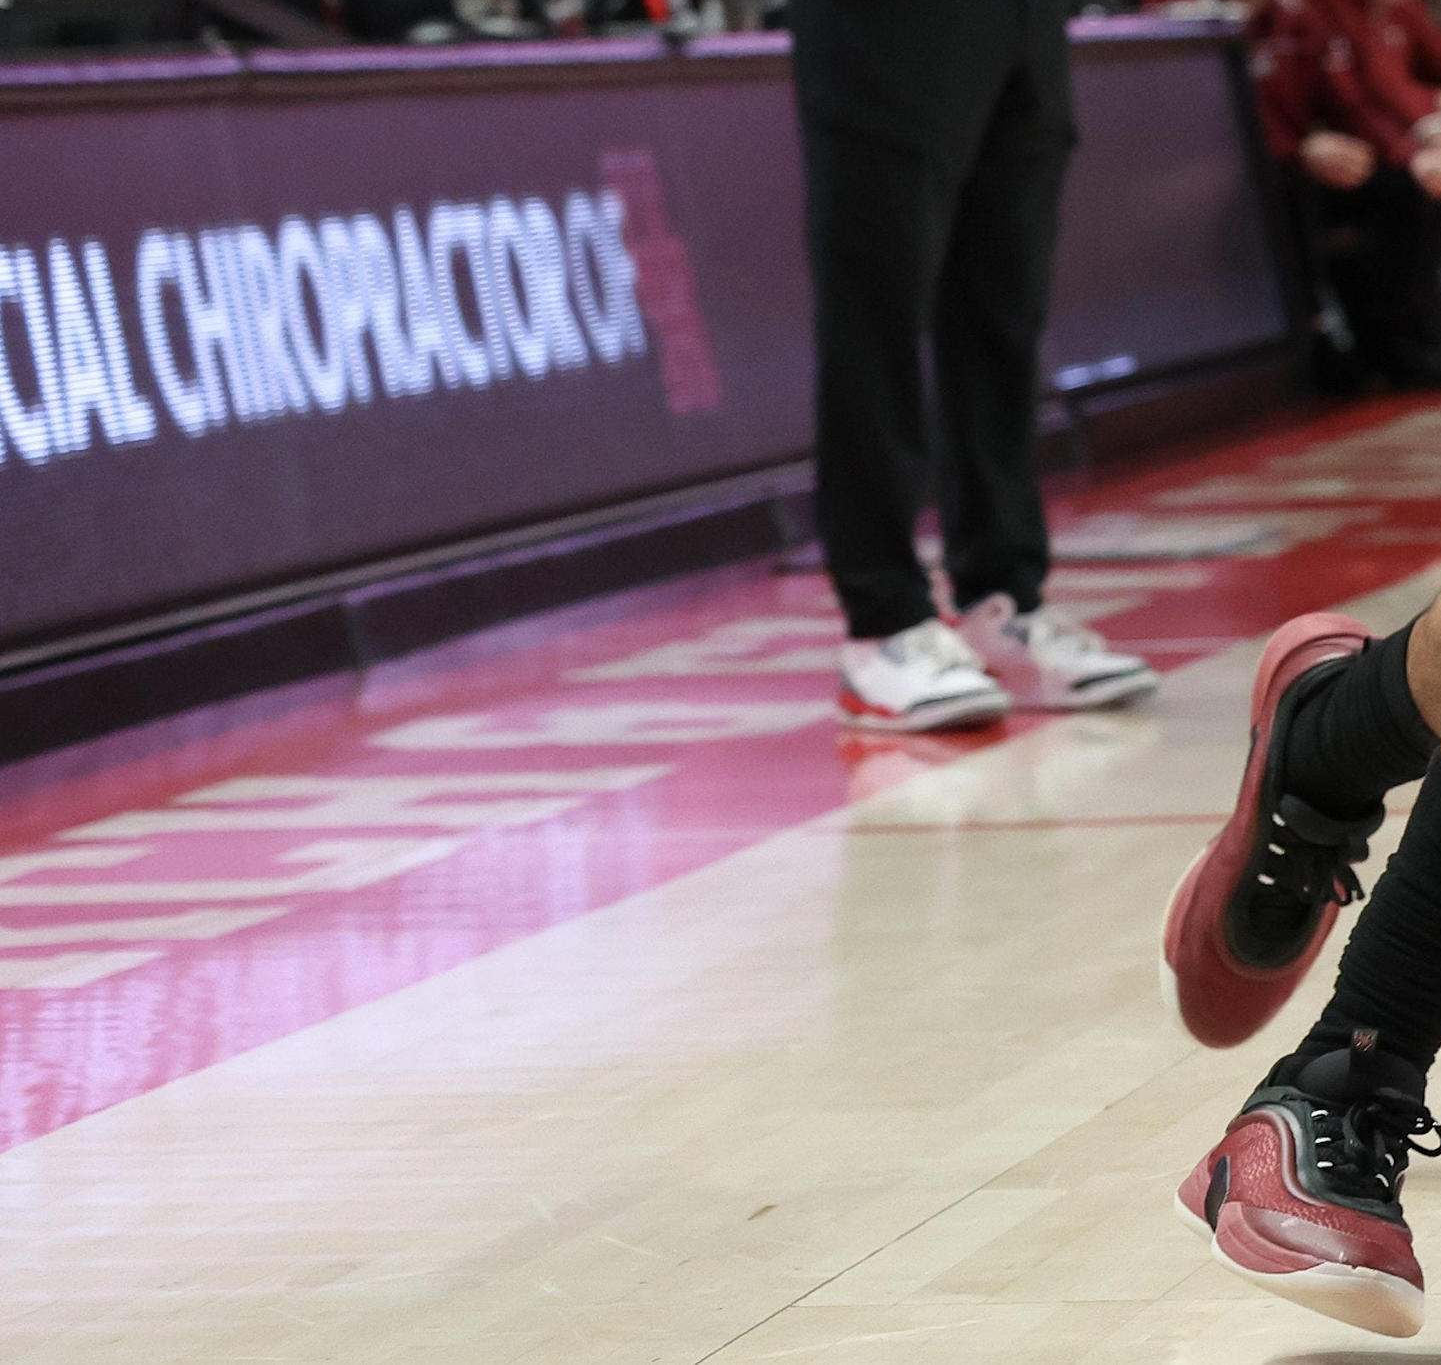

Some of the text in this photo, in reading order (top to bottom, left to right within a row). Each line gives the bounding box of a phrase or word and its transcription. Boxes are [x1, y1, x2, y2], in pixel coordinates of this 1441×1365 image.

[0, 188, 648, 467] CIAL CHIROPRACTOR OF
